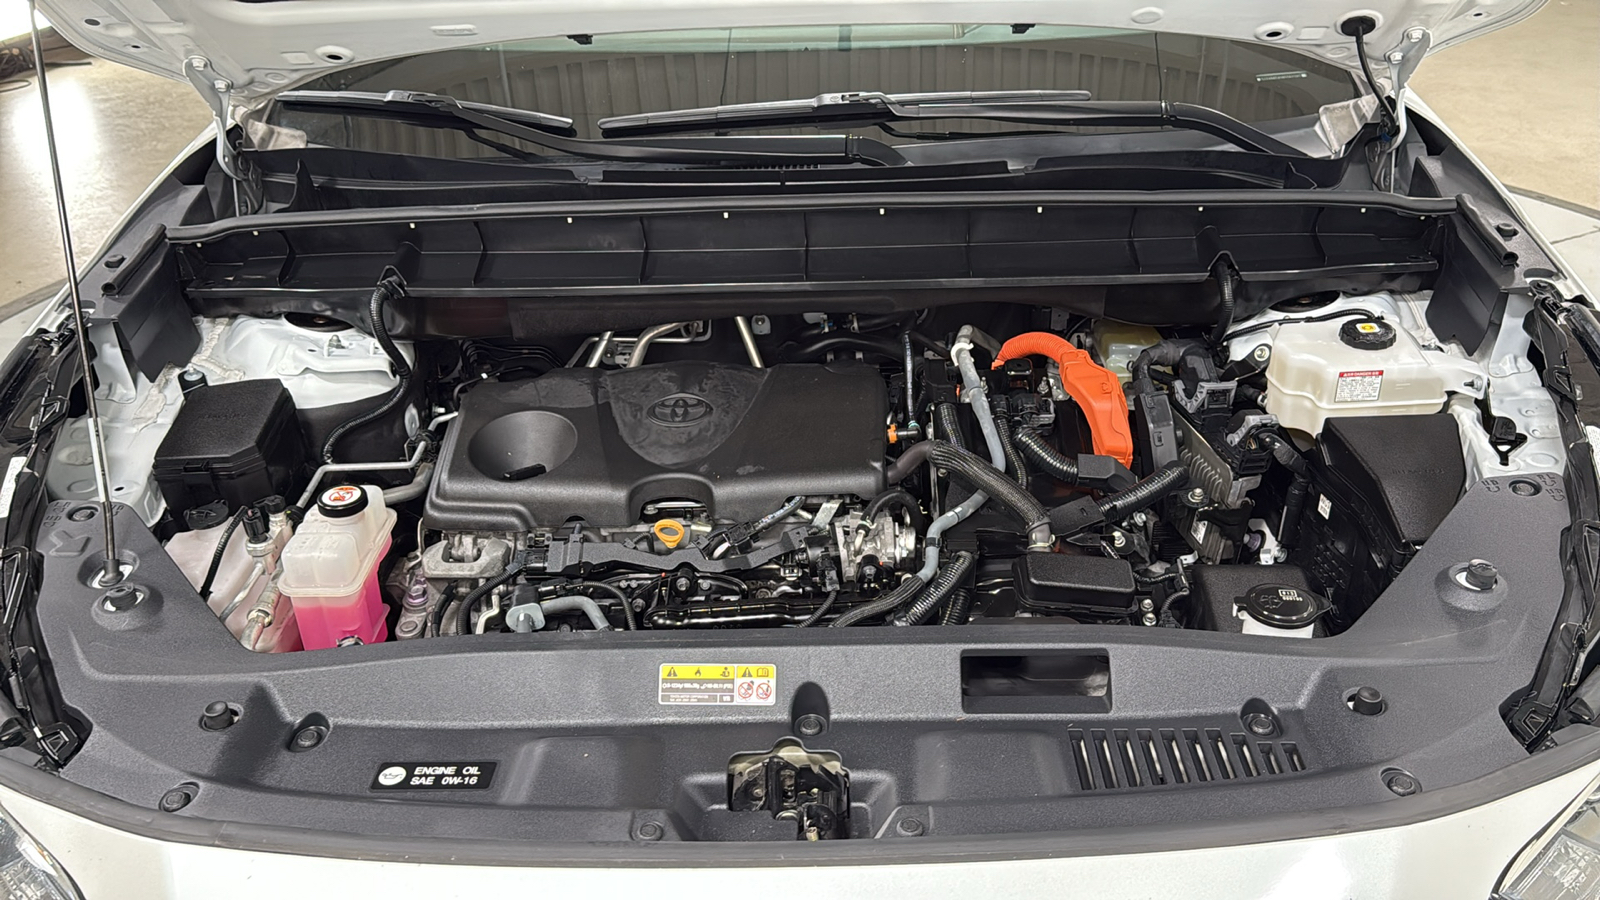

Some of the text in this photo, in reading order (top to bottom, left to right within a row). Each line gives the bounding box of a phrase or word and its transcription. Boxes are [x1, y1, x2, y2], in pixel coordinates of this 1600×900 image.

[413, 766, 481, 775] ENGINE OIL
[409, 776, 478, 785] SAE 0W-16
